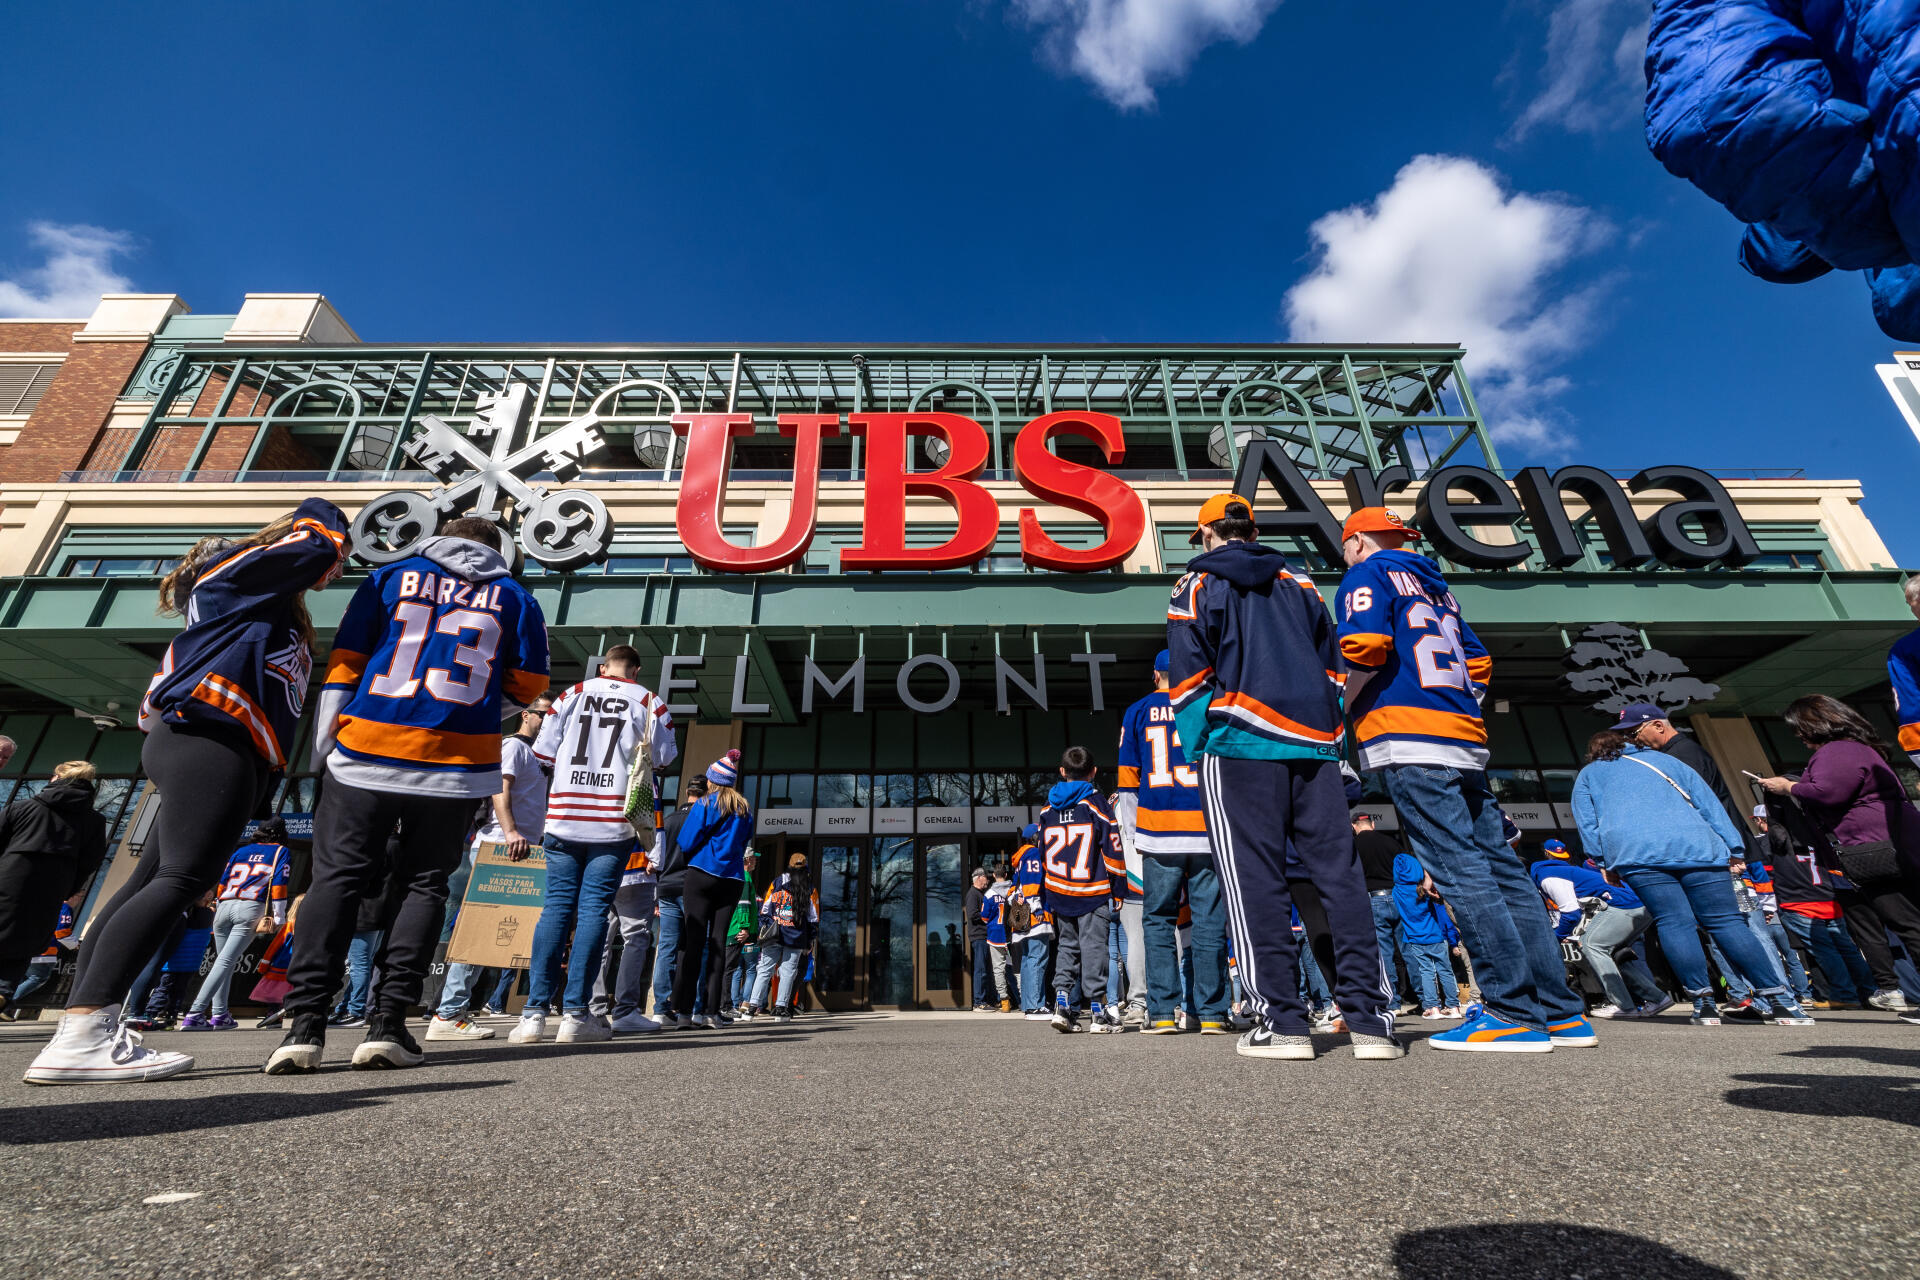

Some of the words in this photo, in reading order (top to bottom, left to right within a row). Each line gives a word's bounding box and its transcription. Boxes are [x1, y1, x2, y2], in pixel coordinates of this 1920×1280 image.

[669, 410, 1146, 574] UBS
[1231, 439, 1762, 571] Arena
[400, 571, 503, 612] BARZAL
[368, 601, 503, 706] 13
[584, 653, 1117, 714] ELMONT
[583, 695, 629, 714] NCP
[1149, 706, 1175, 722] BAR
[570, 714, 627, 769] 17
[1318, 746, 1336, 756] CC
[570, 770, 615, 788] REIMER
[764, 818, 804, 826] GENERAL
[828, 817, 856, 825] ENTRY
[924, 816, 964, 824] GENERAL
[987, 815, 1015, 824] ENTRY
[1059, 811, 1074, 824] LEE
[1512, 812, 1539, 820] ENTRY
[248, 854, 265, 862] LEE
[1044, 823, 1093, 880] 27
[1026, 860, 1040, 873] 13
[219, 862, 273, 900] 27
[489, 877, 514, 888] VASOS
[514, 879, 534, 889] PARA
[477, 883, 505, 894] BEBIDA
[506, 886, 541, 897] CALIENTE
[60, 915, 72, 924] 13
[52, 958, 77, 975] Are
